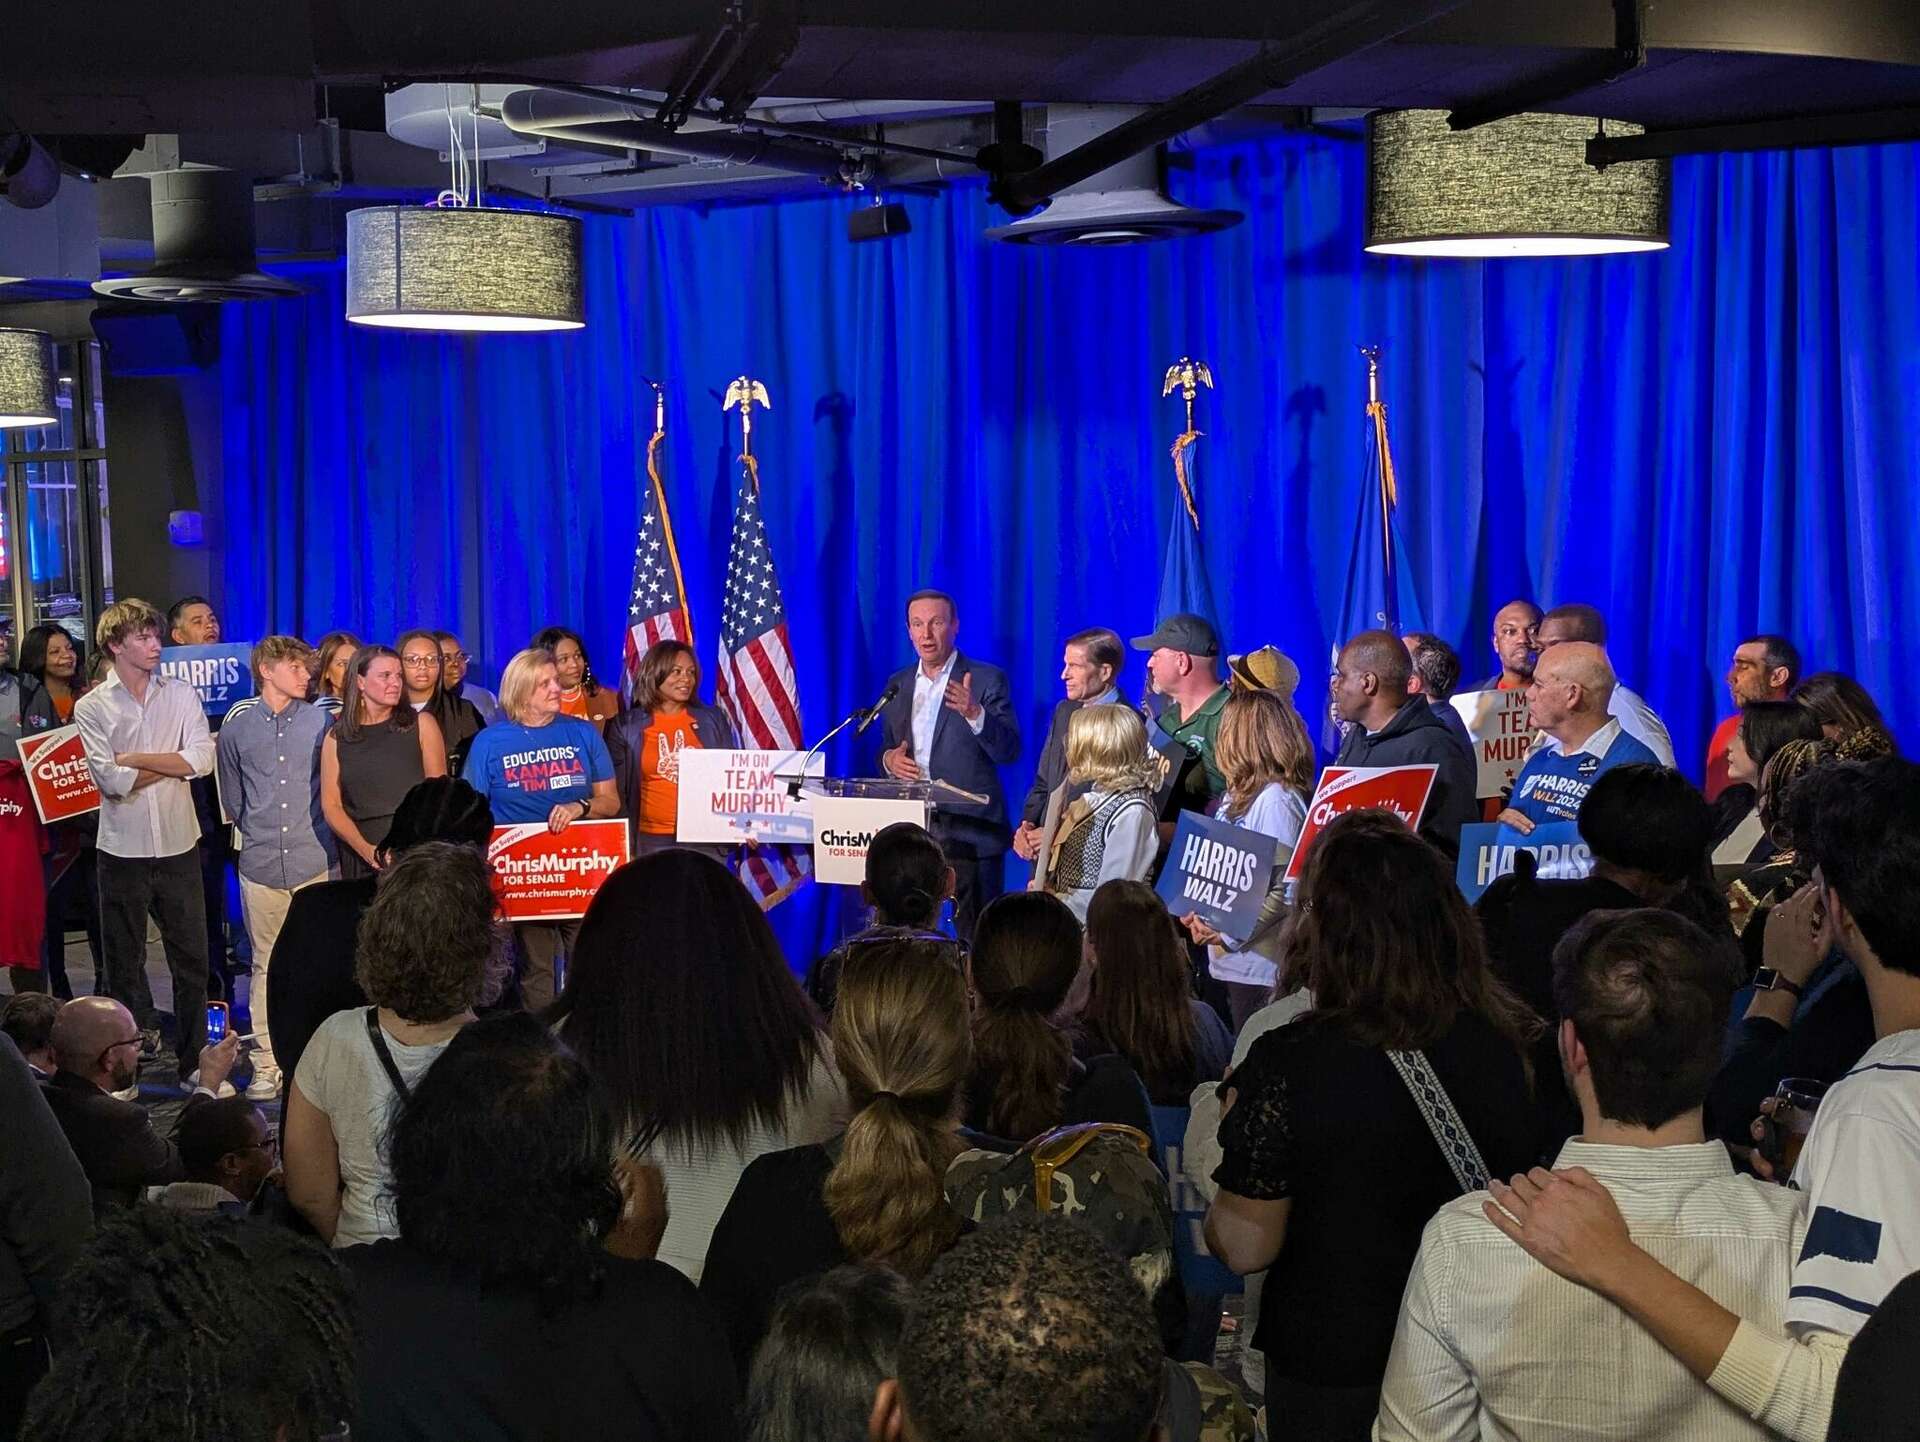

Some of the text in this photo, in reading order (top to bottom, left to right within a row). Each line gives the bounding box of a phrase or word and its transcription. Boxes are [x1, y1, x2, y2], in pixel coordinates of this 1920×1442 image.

[196, 686, 228, 702] ALZ
[503, 746, 575, 768] EDUCATORS
[731, 753, 769, 768] I'M ON
[505, 758, 584, 781] KAMALA
[52, 775, 76, 789] FOR
[521, 779, 547, 792] TIM
[724, 770, 775, 790] TEAM
[1538, 774, 1592, 798] HARRIS
[712, 792, 787, 814] MURPHY
[1556, 794, 1582, 810] 2024
[500, 830, 524, 847] Support
[820, 829, 872, 847] ChrisM
[829, 848, 870, 857] FOR SENA
[494, 848, 619, 876] ChrisMurphy
[1180, 833, 1257, 892] HARRIS
[503, 874, 565, 885] FOR SENATE
[1183, 876, 1238, 913] WALZ
